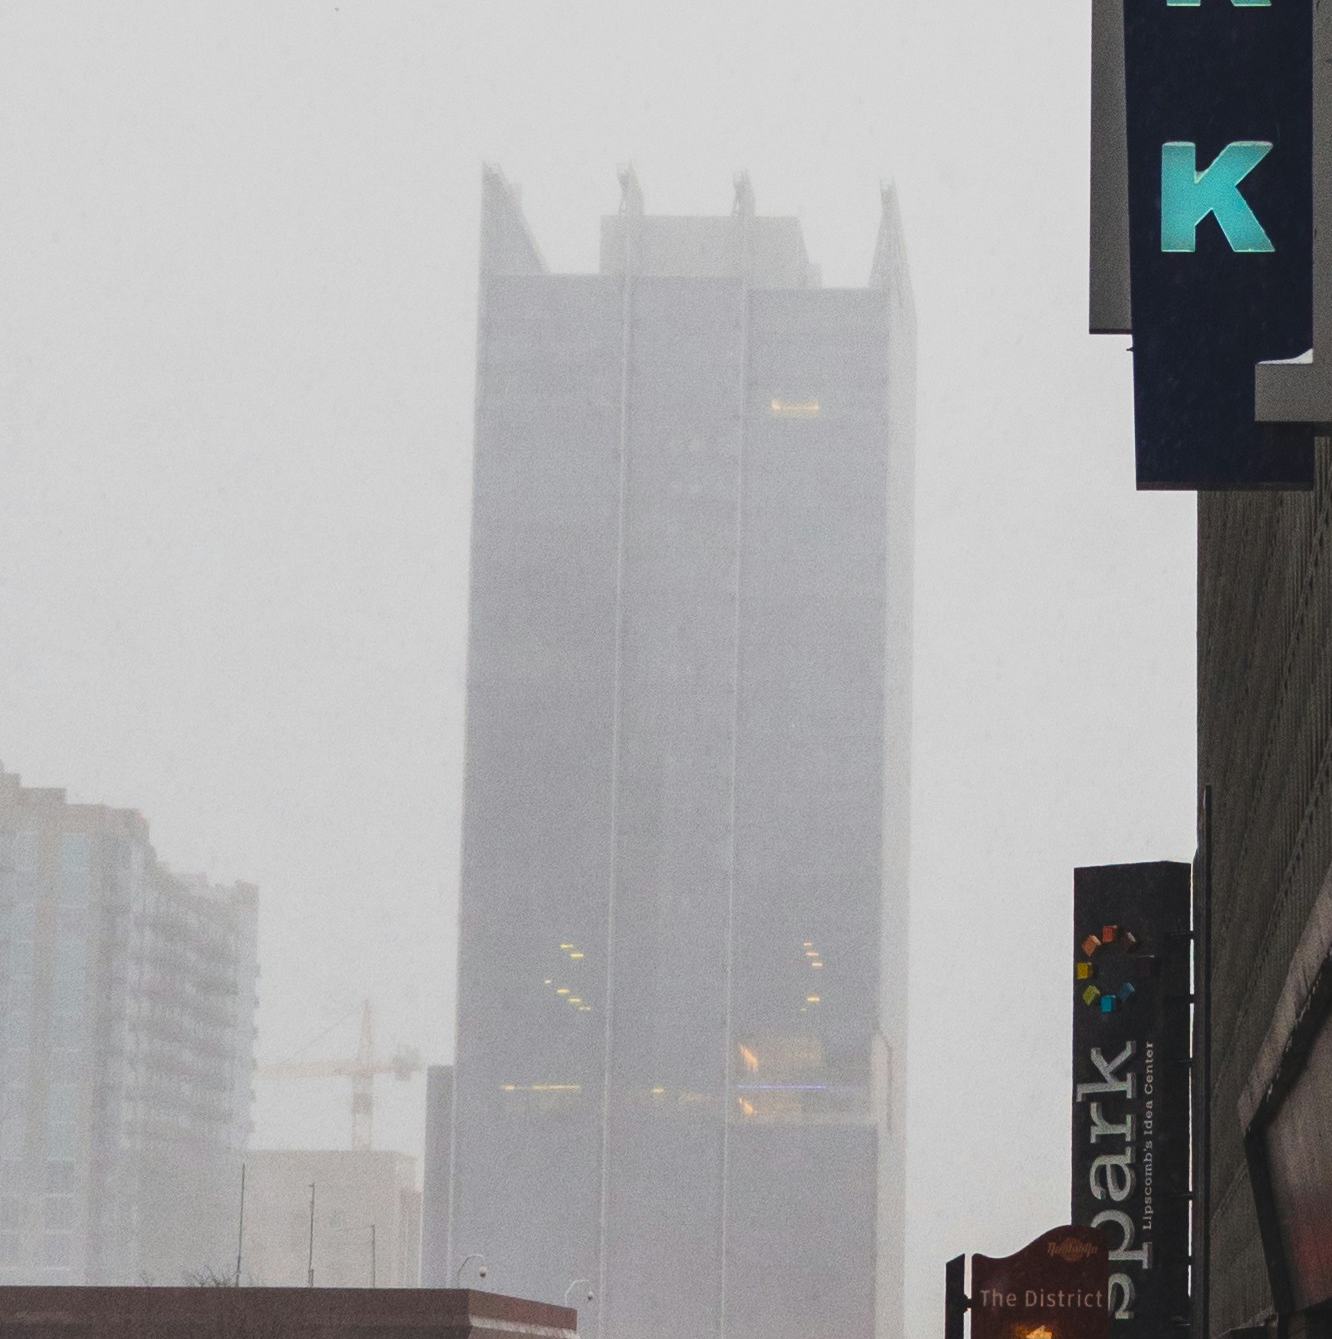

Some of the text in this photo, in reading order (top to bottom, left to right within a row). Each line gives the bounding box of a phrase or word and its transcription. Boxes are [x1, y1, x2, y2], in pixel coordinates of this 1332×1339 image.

[1142, 1041, 1154, 1231] Lipscomb's Idea Center
[980, 1288, 1103, 1308] The District
